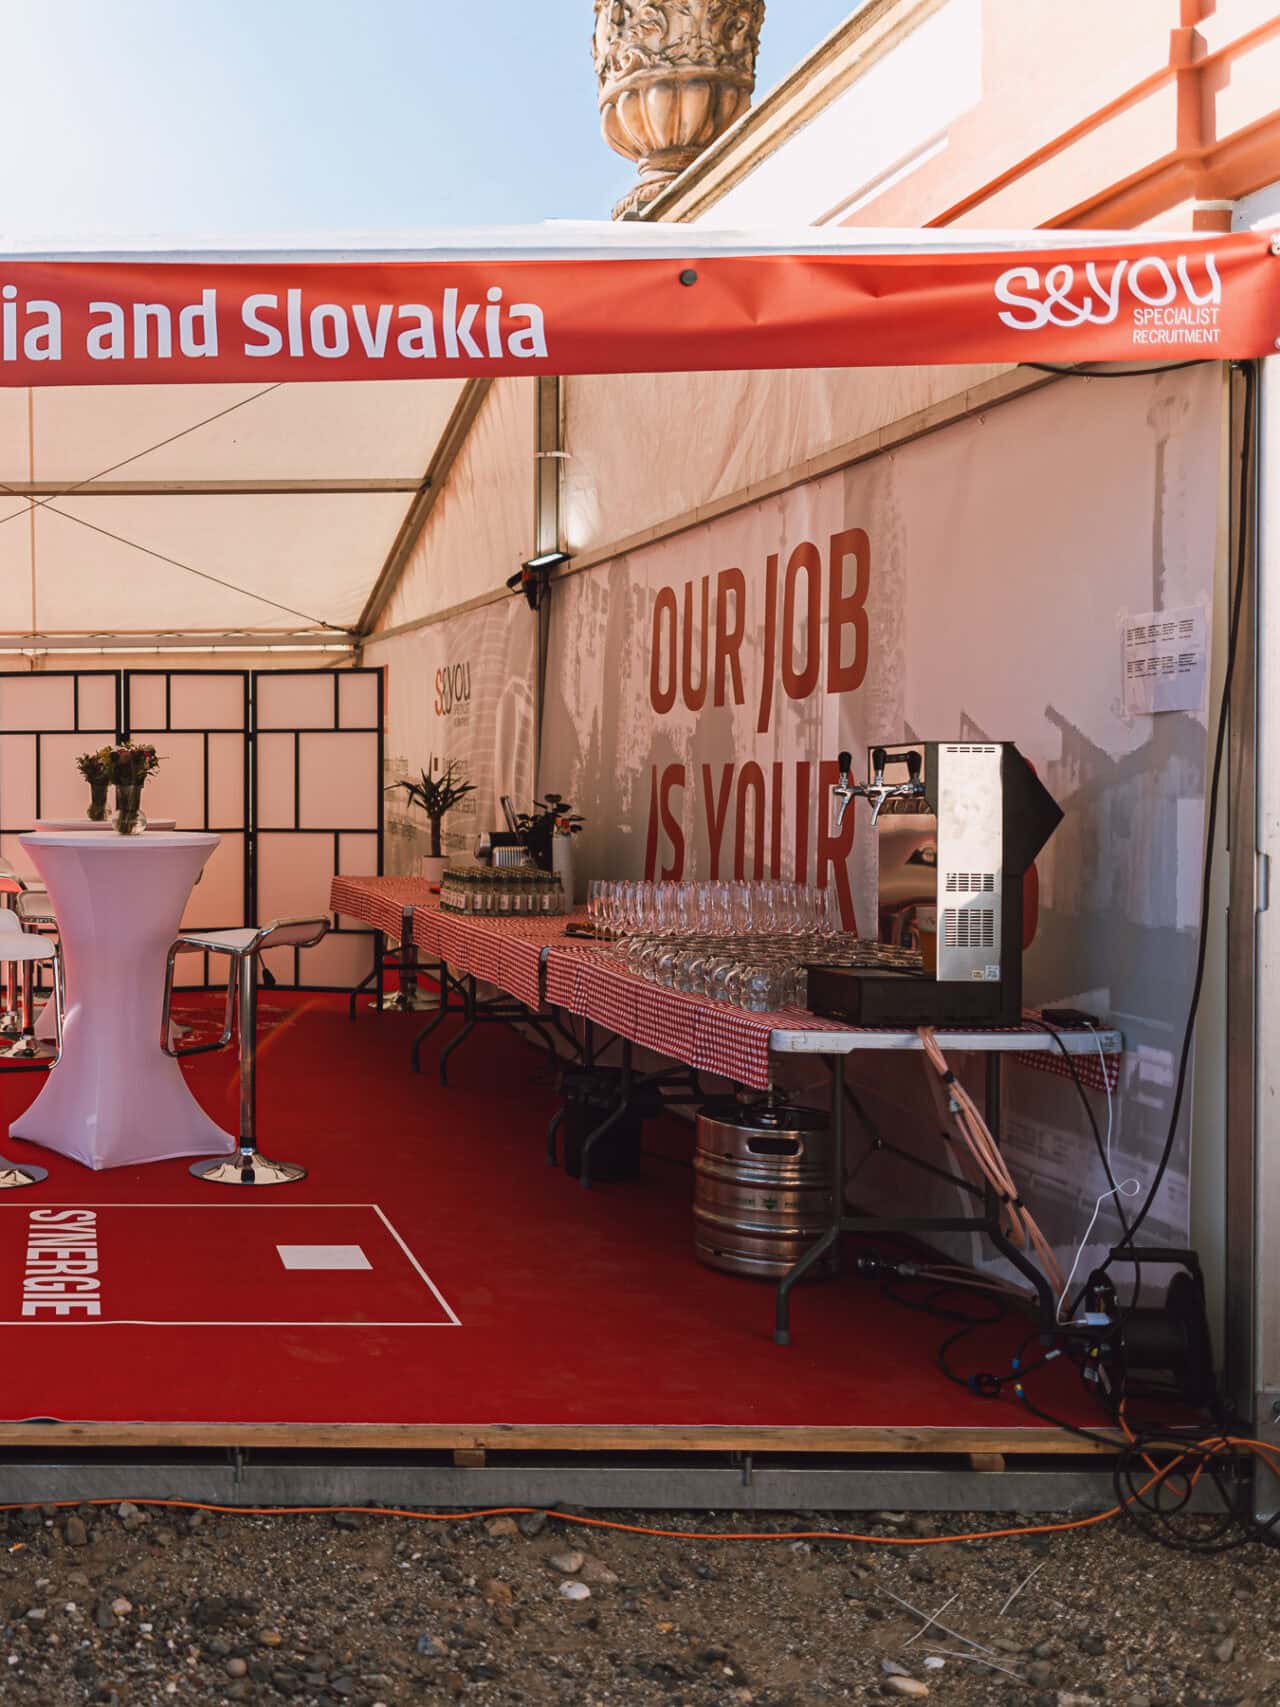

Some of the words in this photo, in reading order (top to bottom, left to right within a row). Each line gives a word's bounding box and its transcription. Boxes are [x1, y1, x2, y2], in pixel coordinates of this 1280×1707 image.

[87, 289, 218, 360] and
[241, 287, 548, 359] Slovakia
[1132, 327, 1220, 344] RECRUITMENT
[1133, 307, 1220, 326] SPECIALIST
[649, 568, 746, 715] OUR
[757, 528, 871, 733] JOB
[644, 762, 686, 880] IS
[701, 760, 858, 937] YOUR
[22, 1209, 102, 1316] SYNERGIE
